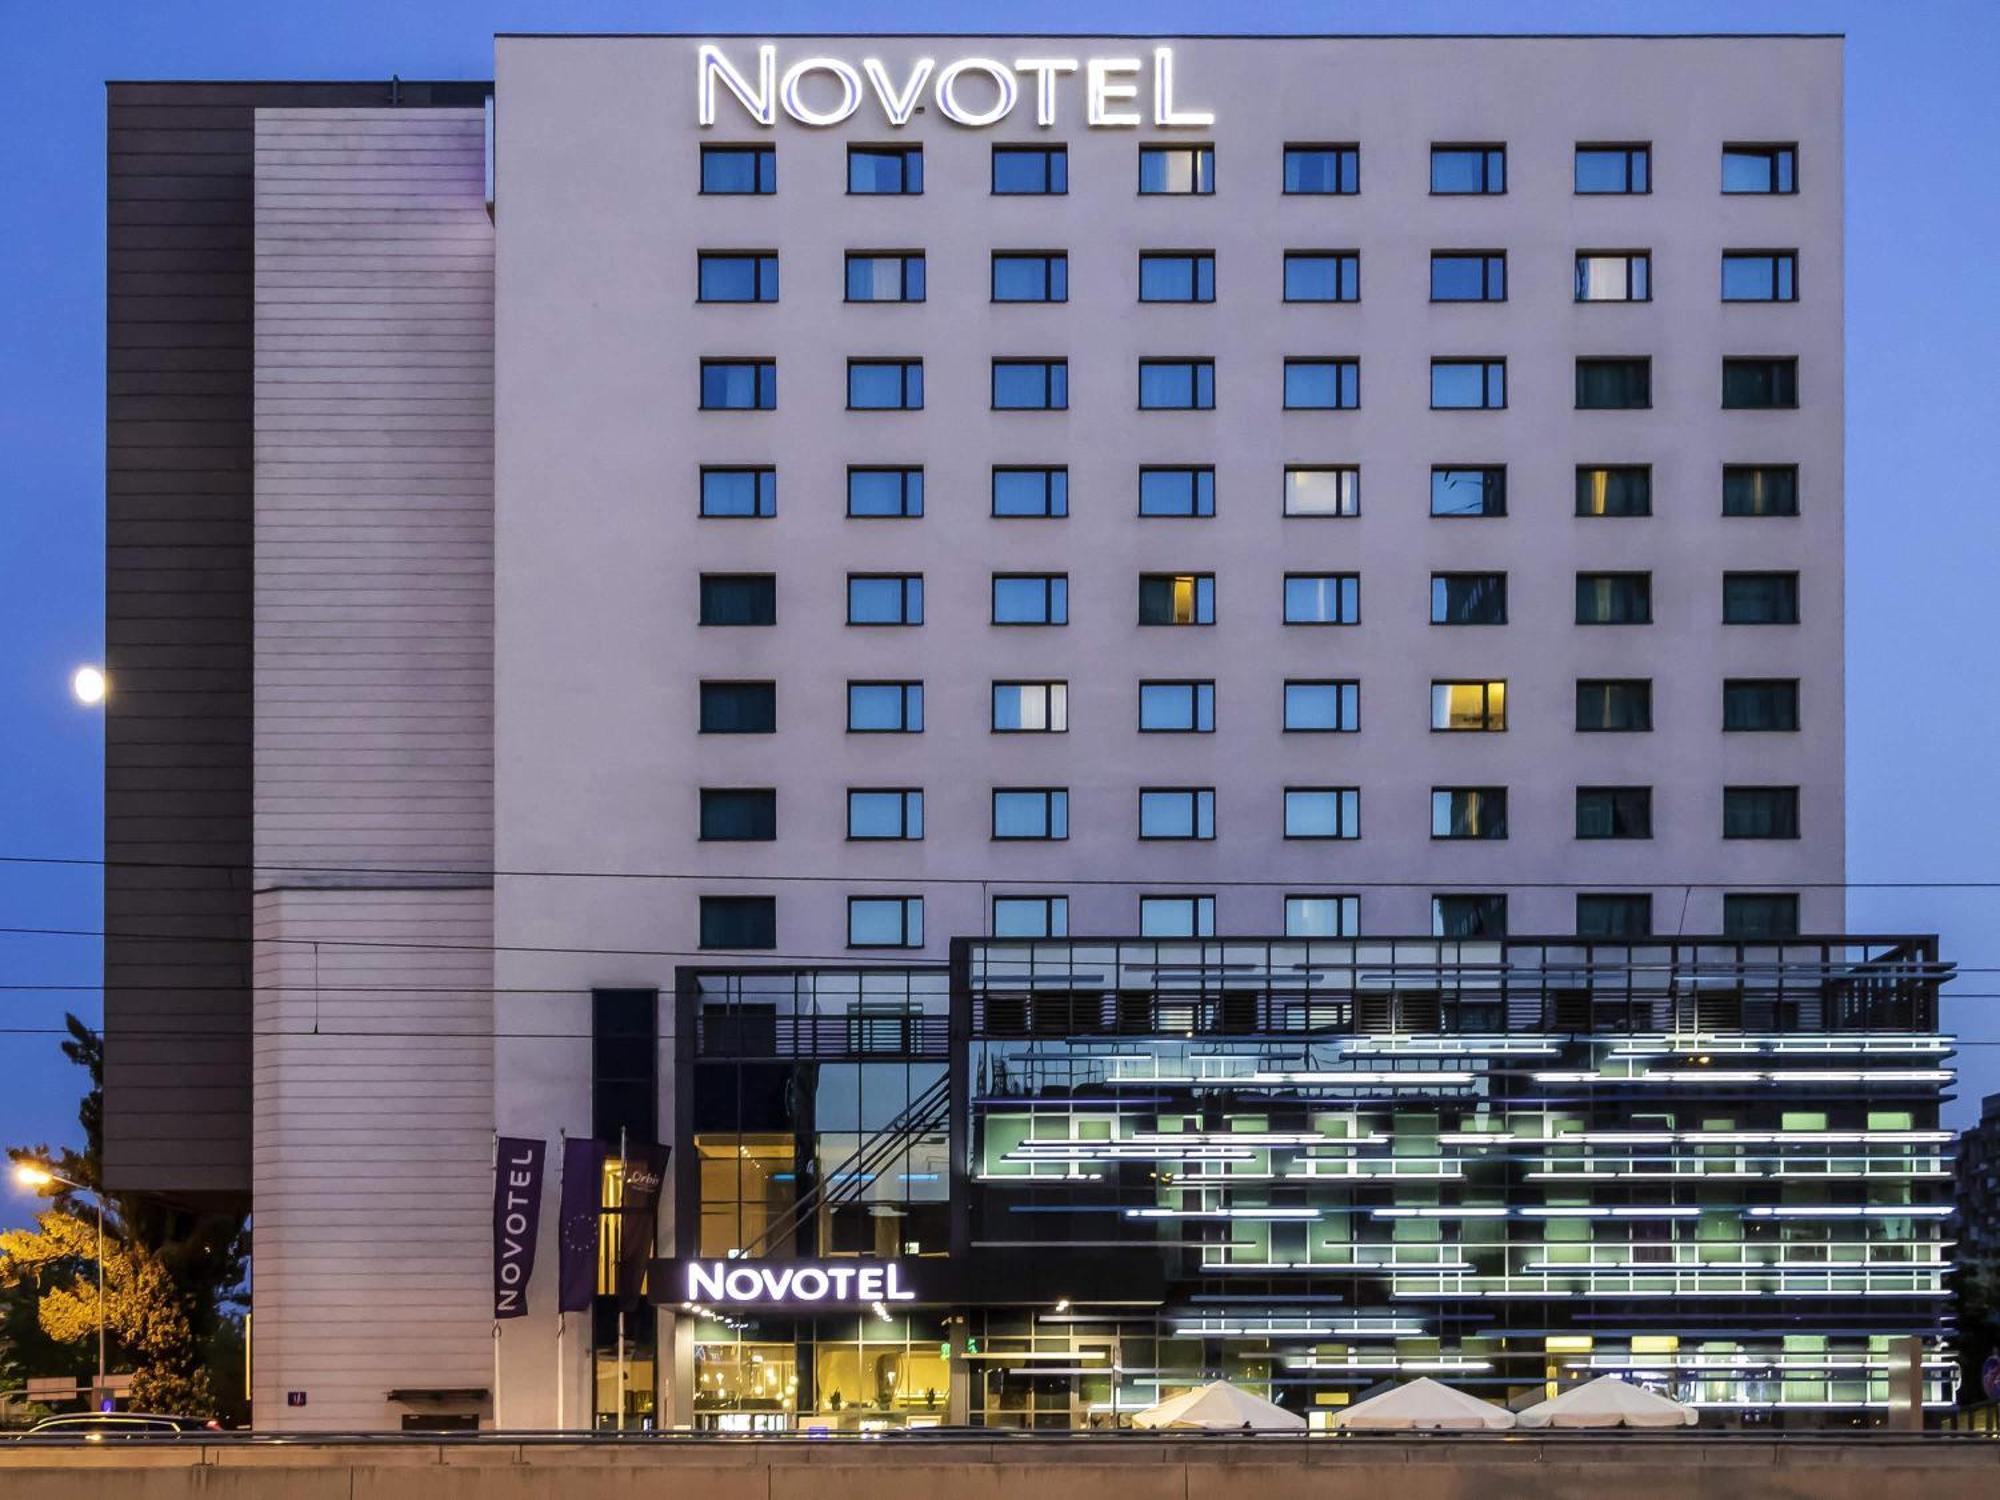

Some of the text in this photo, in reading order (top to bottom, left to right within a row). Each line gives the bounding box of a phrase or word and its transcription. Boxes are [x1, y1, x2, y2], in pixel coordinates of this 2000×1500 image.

[699, 45, 1215, 126] NOVOTEL
[497, 1150, 533, 1310] NOVOTEL
[688, 1262, 915, 1300] NOVOTEL
